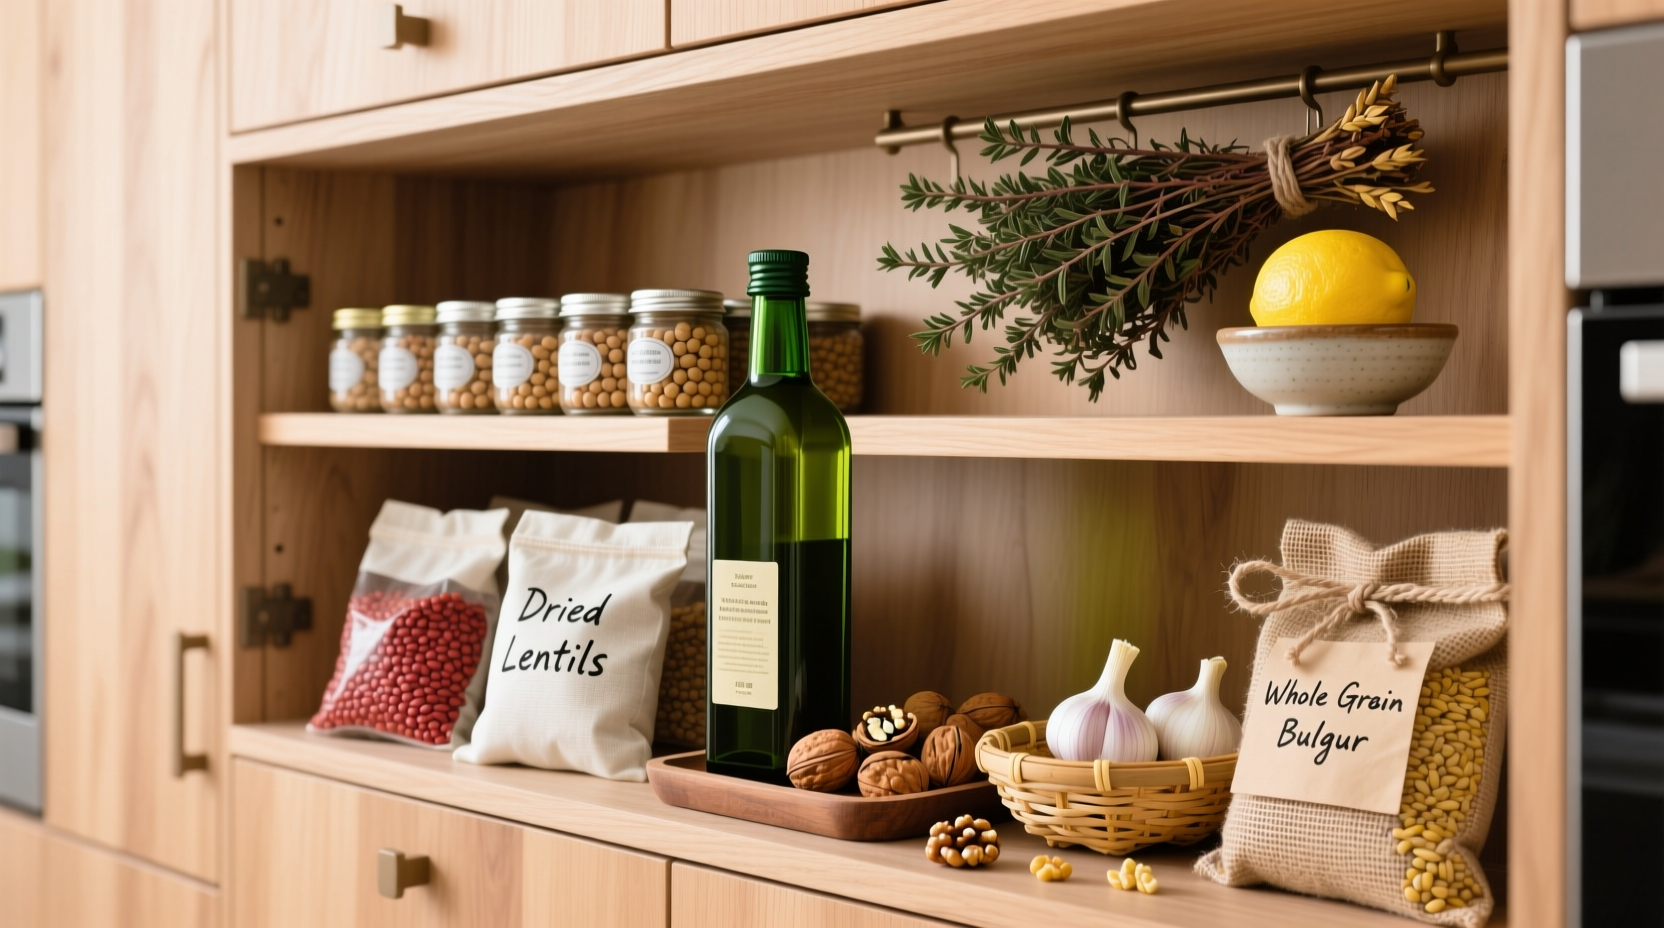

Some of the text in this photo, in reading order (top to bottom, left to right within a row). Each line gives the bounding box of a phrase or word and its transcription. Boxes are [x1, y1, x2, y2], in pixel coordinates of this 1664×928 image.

[517, 587, 612, 626] Dried
[501, 634, 608, 677] Lentils
[1264, 678, 1403, 714] Whole Grain
[1276, 717, 1369, 766] Bulgur
